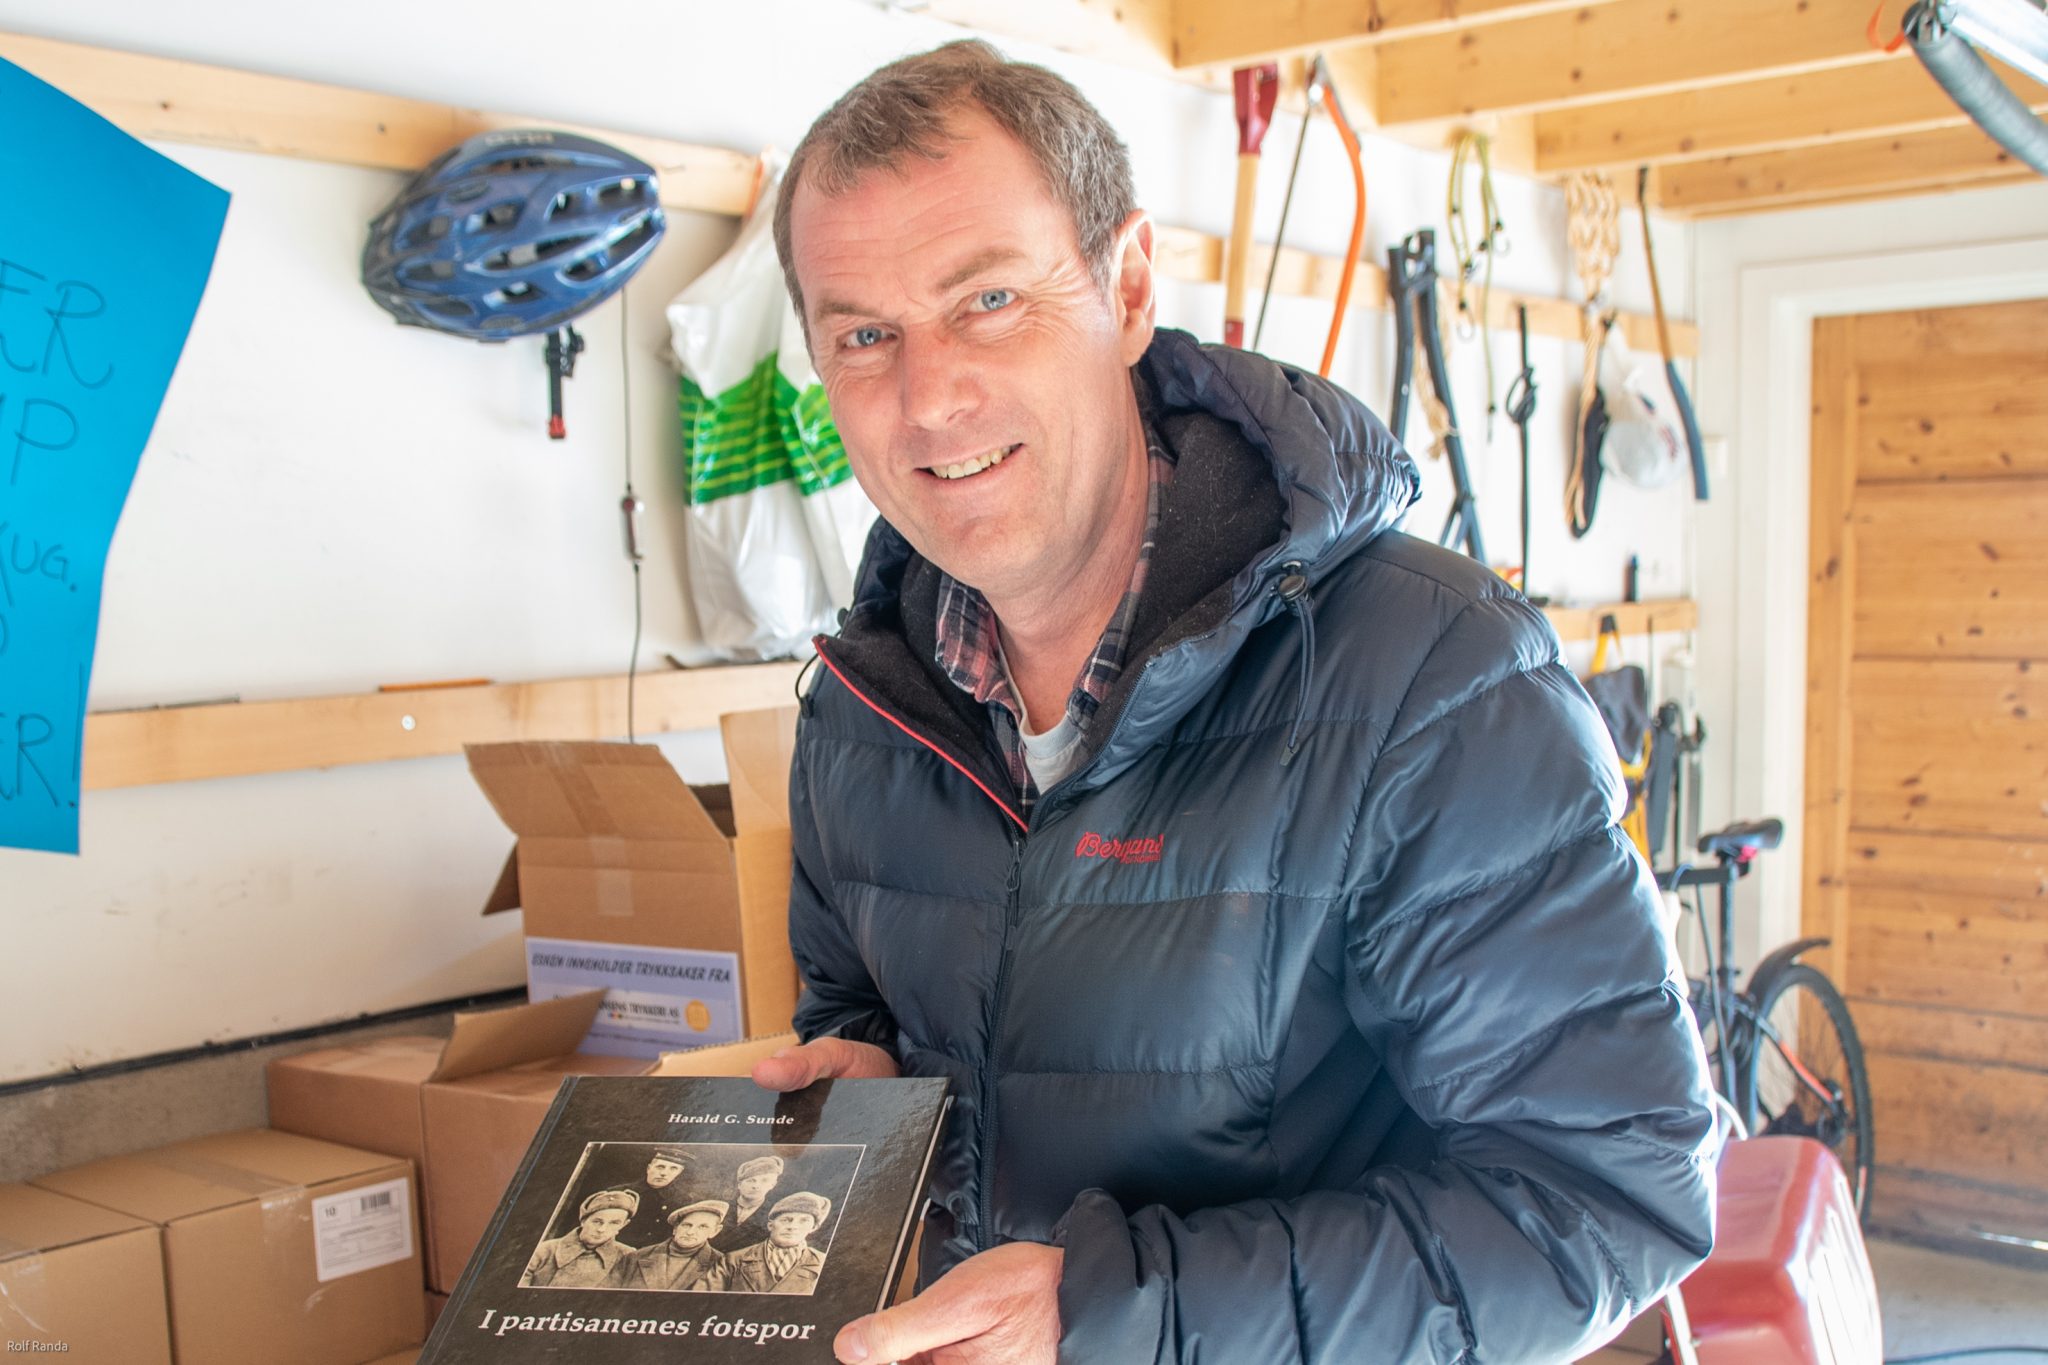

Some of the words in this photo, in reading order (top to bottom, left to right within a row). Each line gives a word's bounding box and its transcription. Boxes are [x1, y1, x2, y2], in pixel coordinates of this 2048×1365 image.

[636, 961, 705, 981] TRYKKSAKER
[708, 967, 730, 983] FRA
[667, 1113, 720, 1124] Harald
[724, 1114, 740, 1125] G.
[745, 1115, 794, 1125] Sunde
[478, 1309, 497, 1330] I
[495, 1311, 690, 1336] partisanenes
[698, 1315, 816, 1345] fotspor
